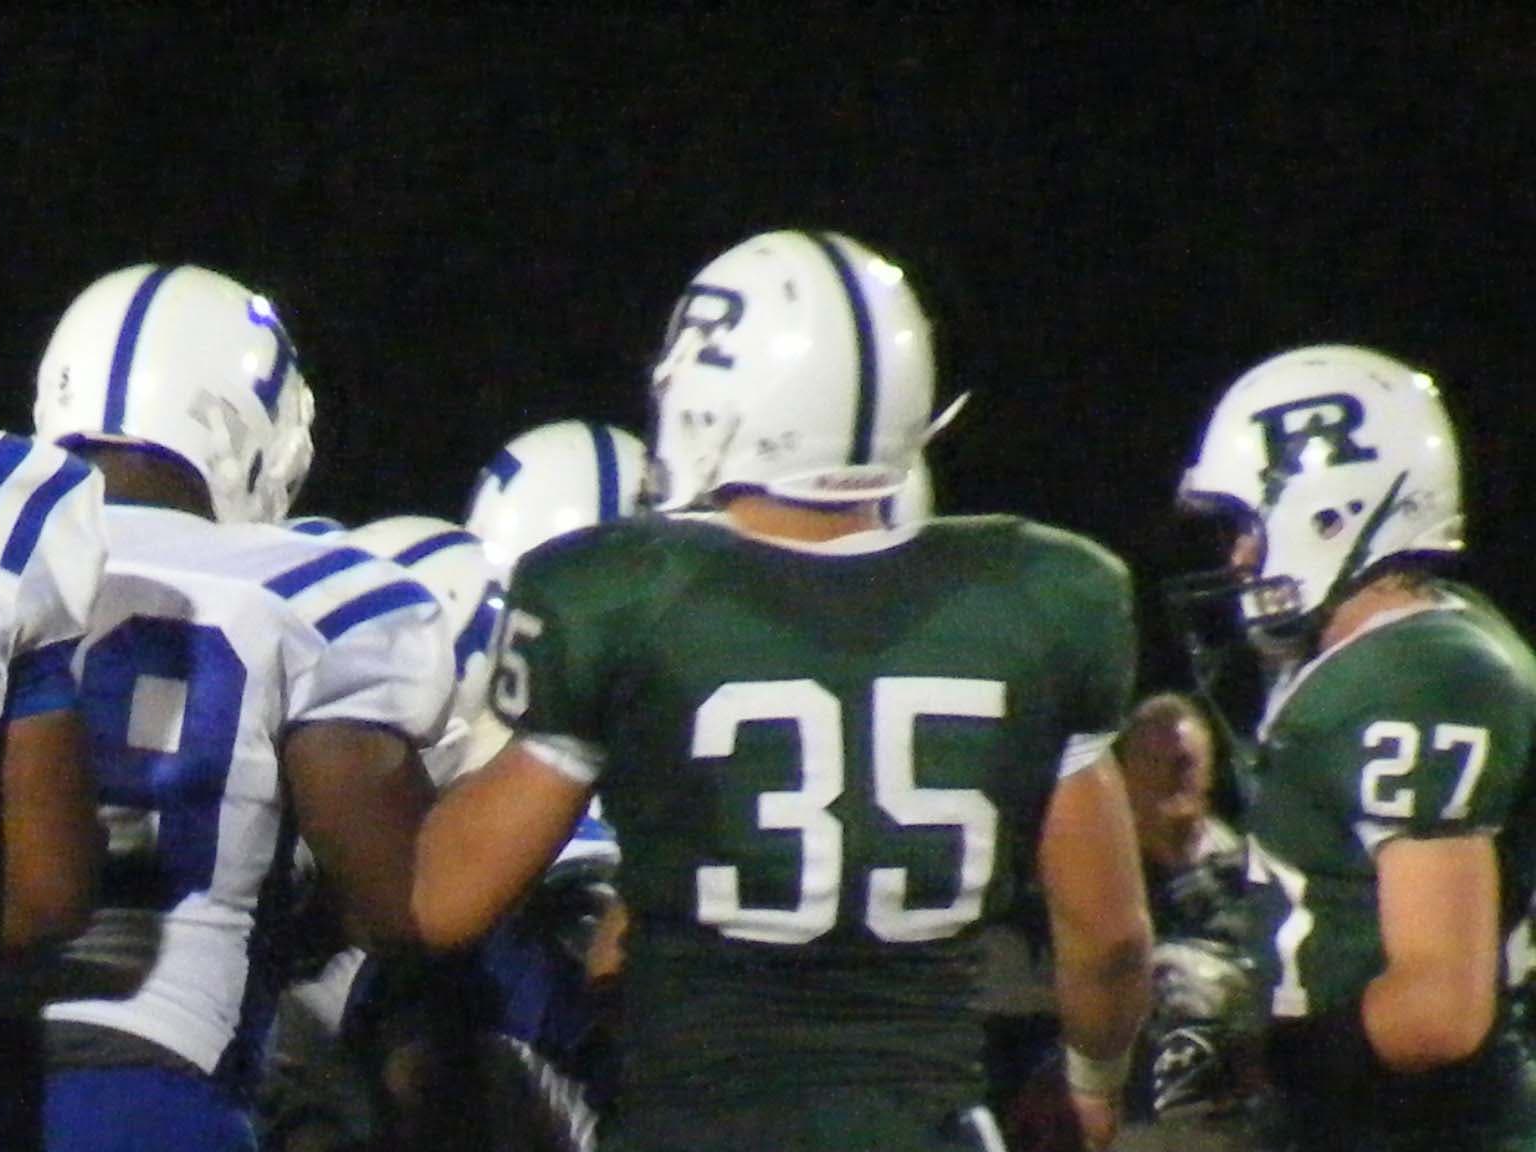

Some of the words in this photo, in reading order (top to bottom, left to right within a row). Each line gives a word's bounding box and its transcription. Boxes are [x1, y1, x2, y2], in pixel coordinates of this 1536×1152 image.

[1250, 392, 1379, 479] R
[692, 676, 1007, 944] 35
[1361, 720, 1491, 820] 27
